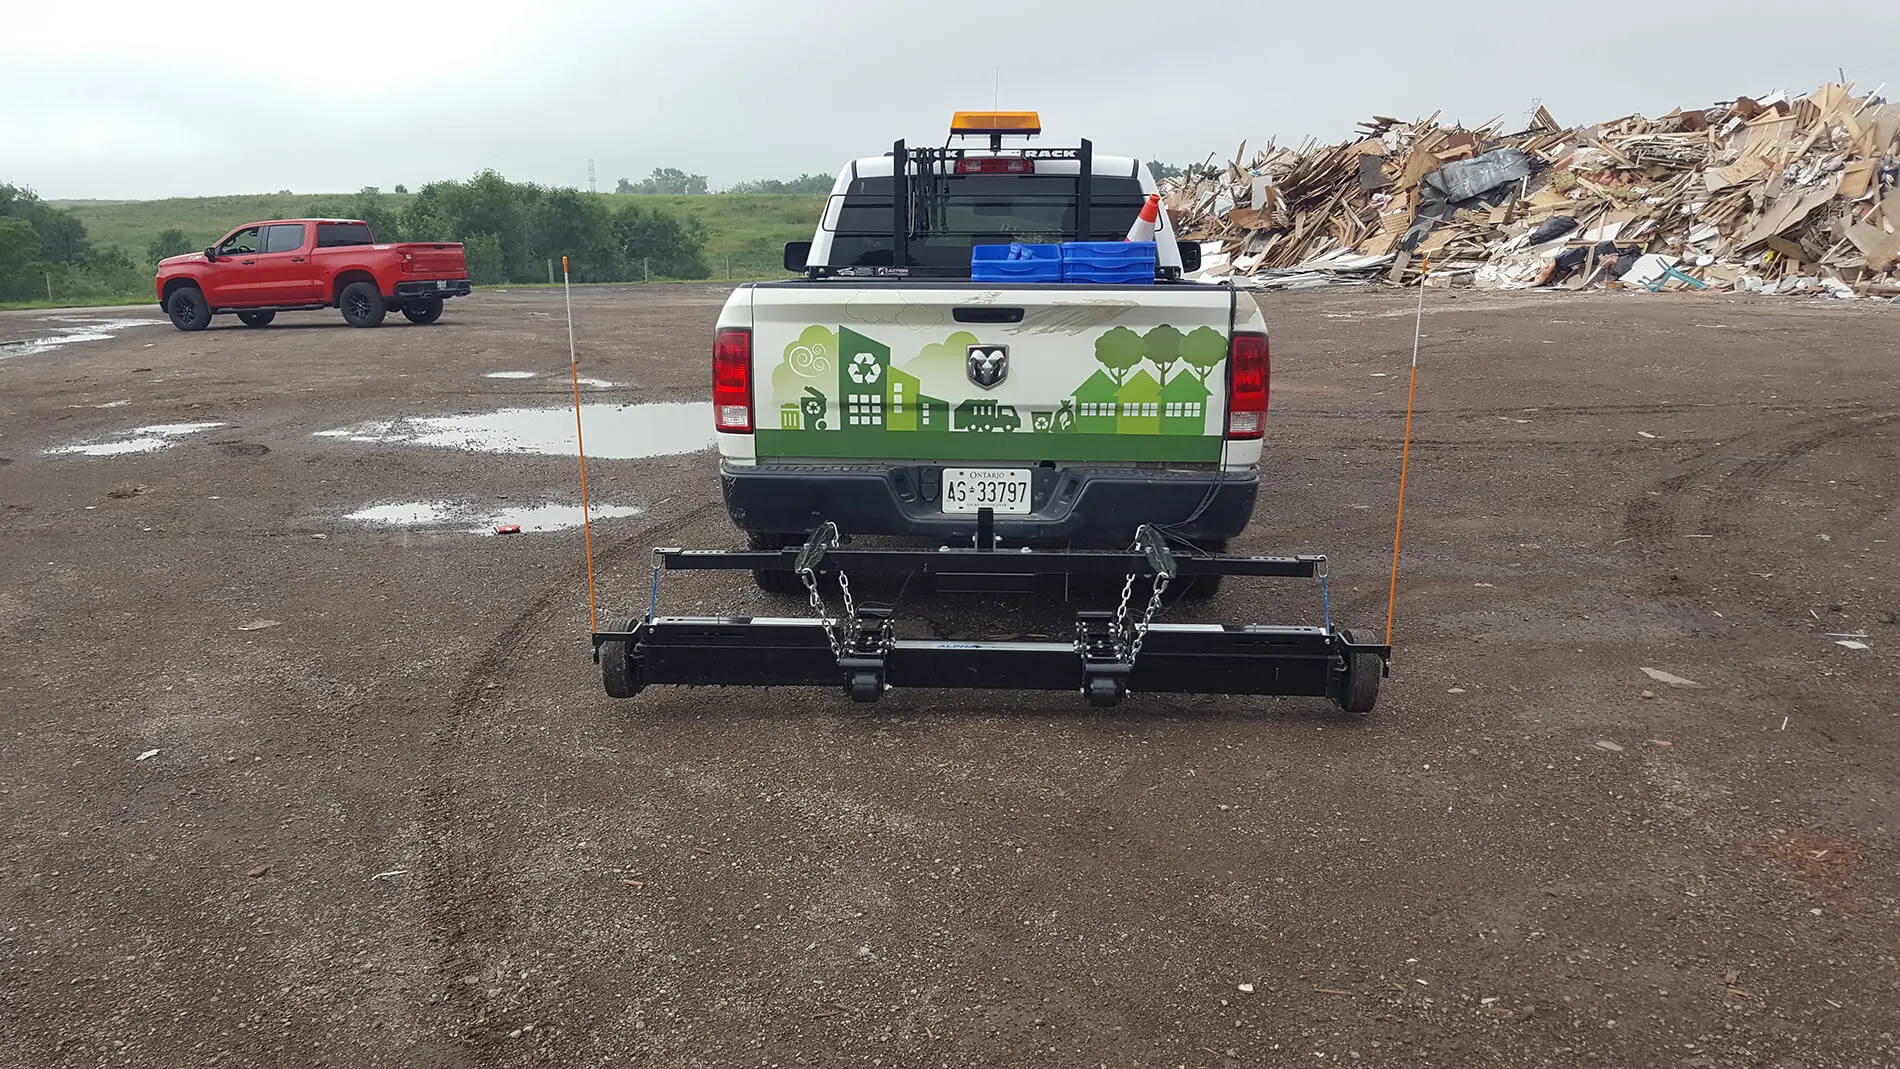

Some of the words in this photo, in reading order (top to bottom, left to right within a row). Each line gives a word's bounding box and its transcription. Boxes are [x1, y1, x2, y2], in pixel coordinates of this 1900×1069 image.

[1025, 150, 1077, 158] RACK
[970, 471, 1005, 479] ONTARIO
[977, 481, 1027, 502] 33797
